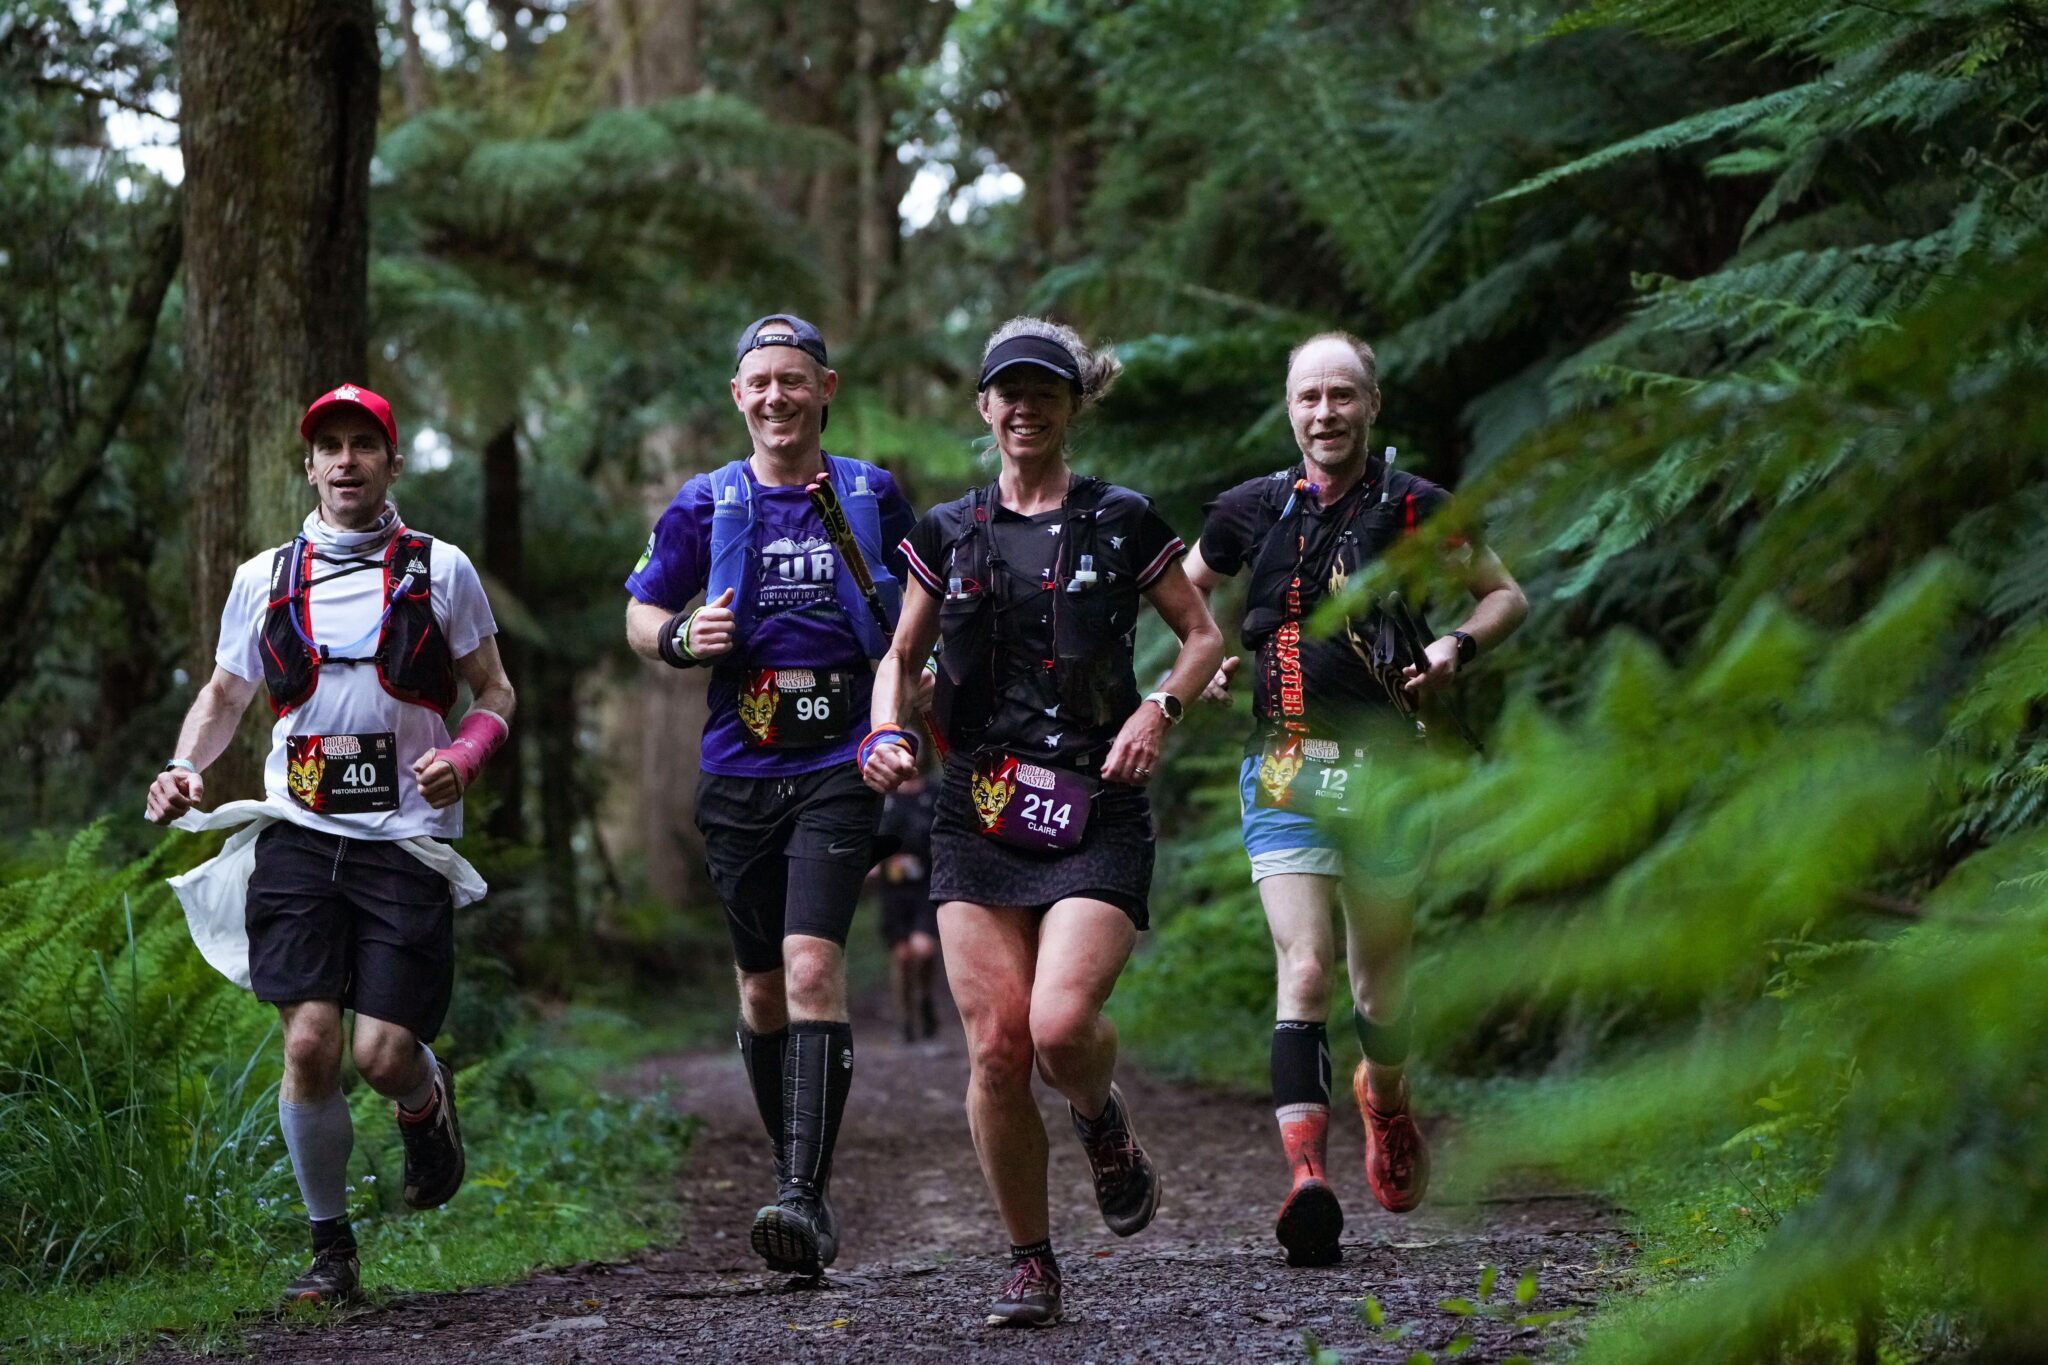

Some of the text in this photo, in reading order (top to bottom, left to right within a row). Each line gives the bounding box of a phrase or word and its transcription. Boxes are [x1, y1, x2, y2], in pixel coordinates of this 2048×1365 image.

[796, 696, 830, 721] 96
[342, 762, 377, 787] 40
[1017, 772, 1055, 789] COASTER
[1019, 764, 1056, 781] ROLLER
[1319, 767, 1348, 792] 12
[1315, 789, 1344, 800] ROO
[1020, 793, 1072, 829] 214
[1027, 821, 1058, 837] CLAIRE
